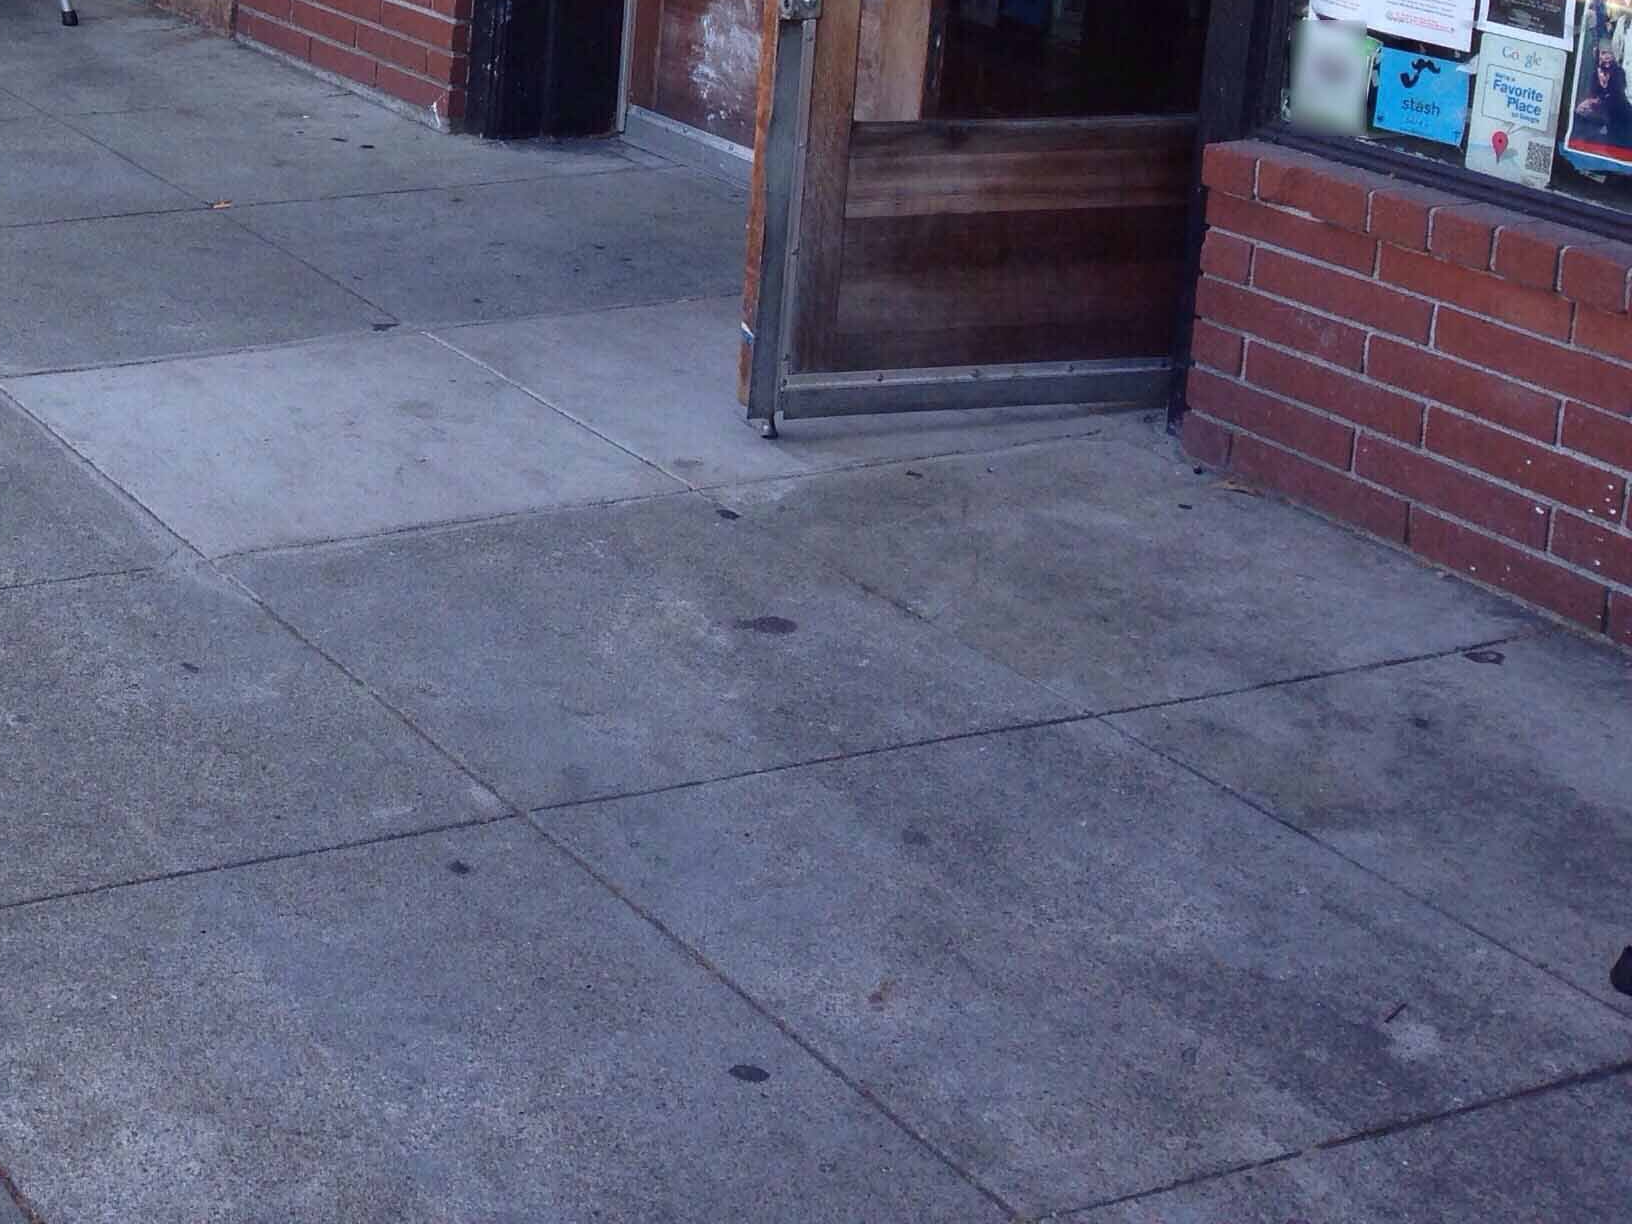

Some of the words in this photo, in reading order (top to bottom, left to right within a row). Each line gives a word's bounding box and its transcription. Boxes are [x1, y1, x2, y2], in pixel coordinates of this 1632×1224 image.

[1502, 46, 1543, 69] Gogle
[1493, 79, 1544, 103] Favorite
[1401, 98, 1441, 117] stash
[1507, 96, 1543, 117] Place
